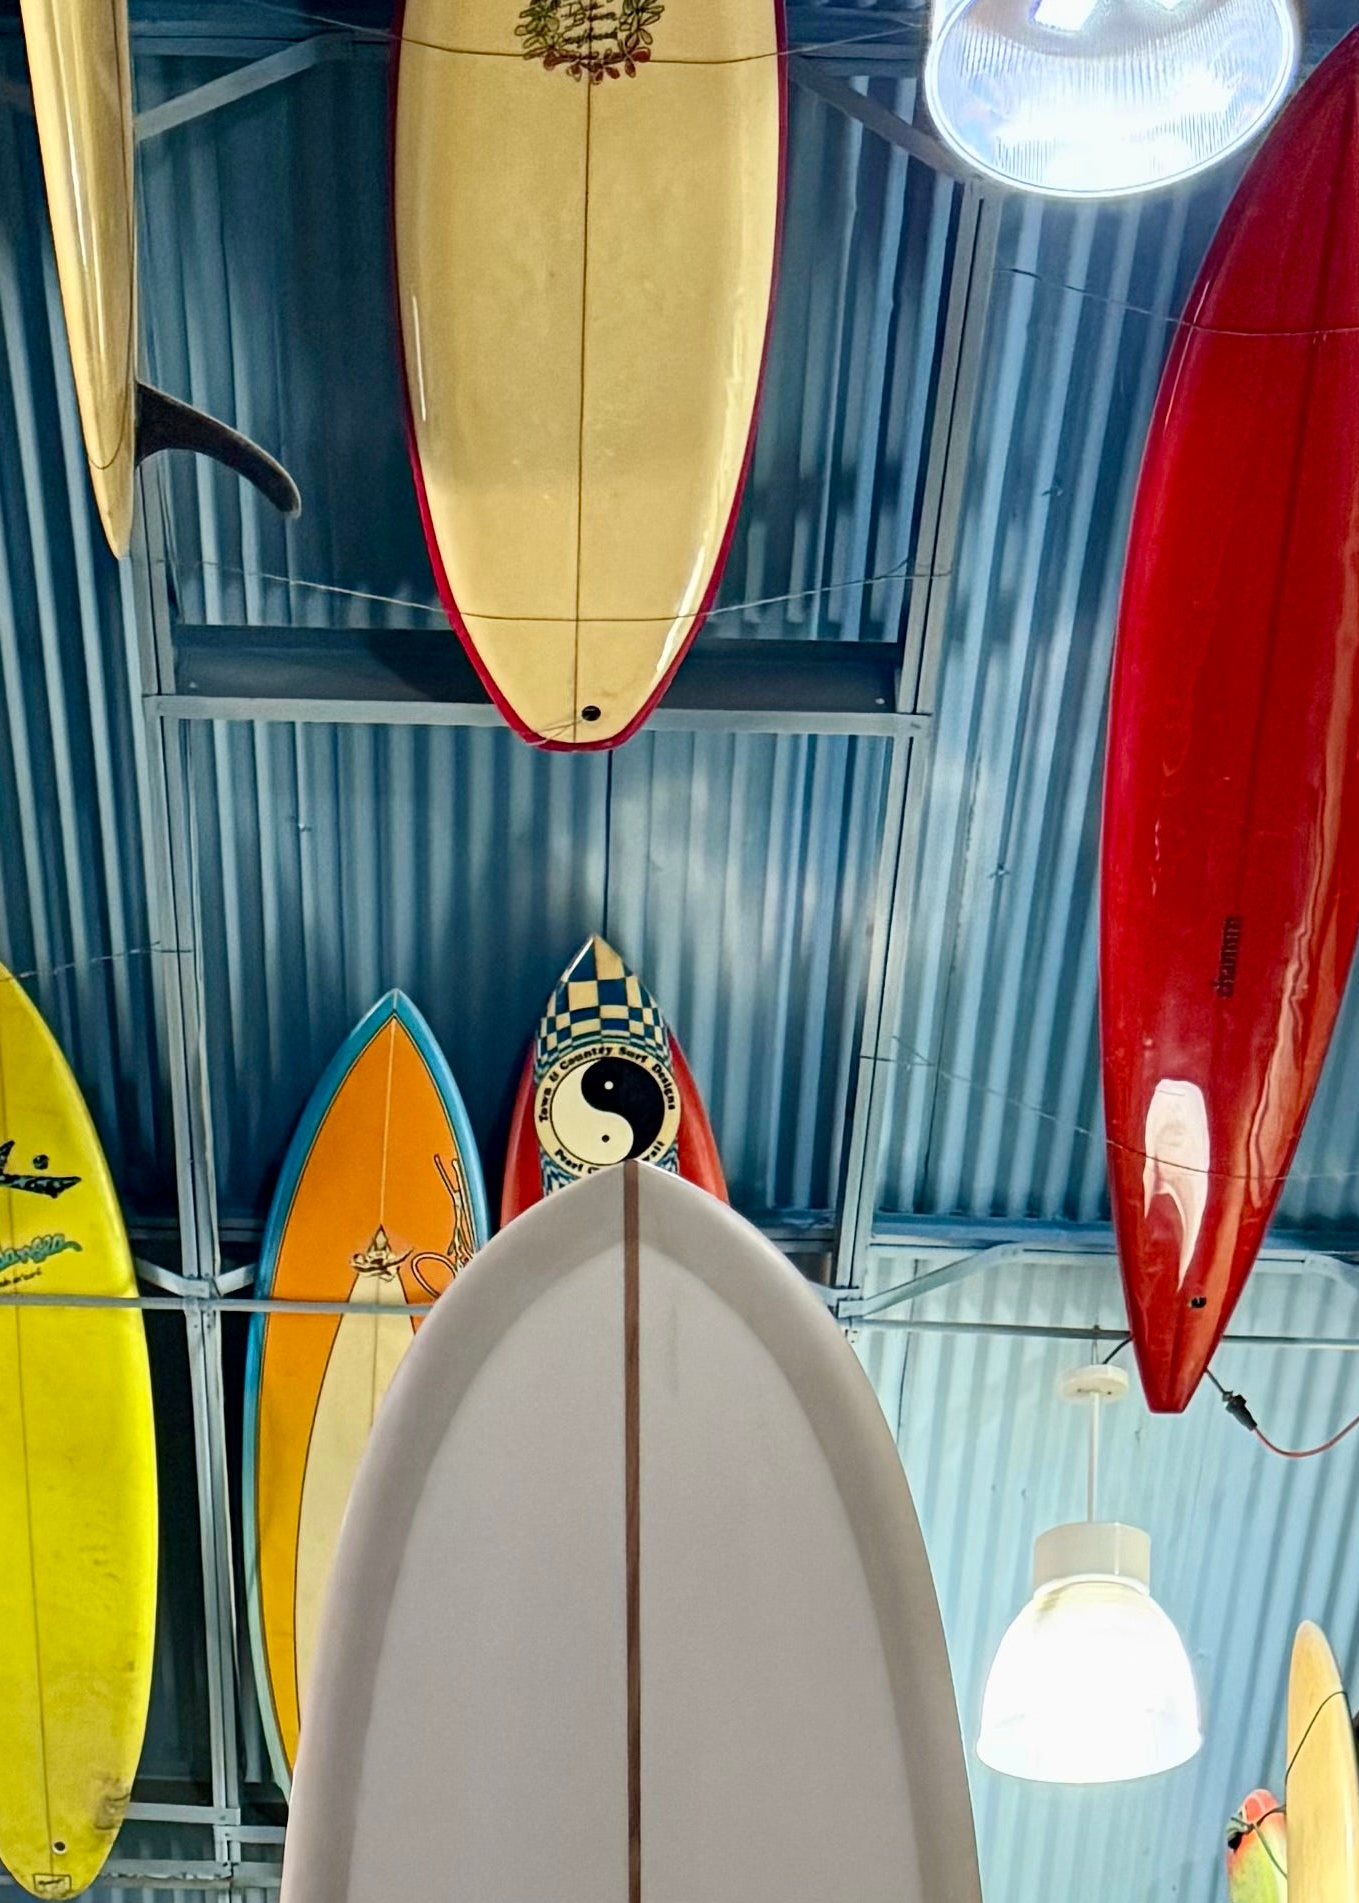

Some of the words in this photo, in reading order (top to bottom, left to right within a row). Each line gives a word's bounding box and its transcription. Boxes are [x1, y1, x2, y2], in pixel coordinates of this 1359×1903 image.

[539, 1088, 552, 1122] Town
[560, 1046, 613, 1070] Country
[618, 1046, 648, 1062] Surf
[652, 1063, 675, 1110] Designs
